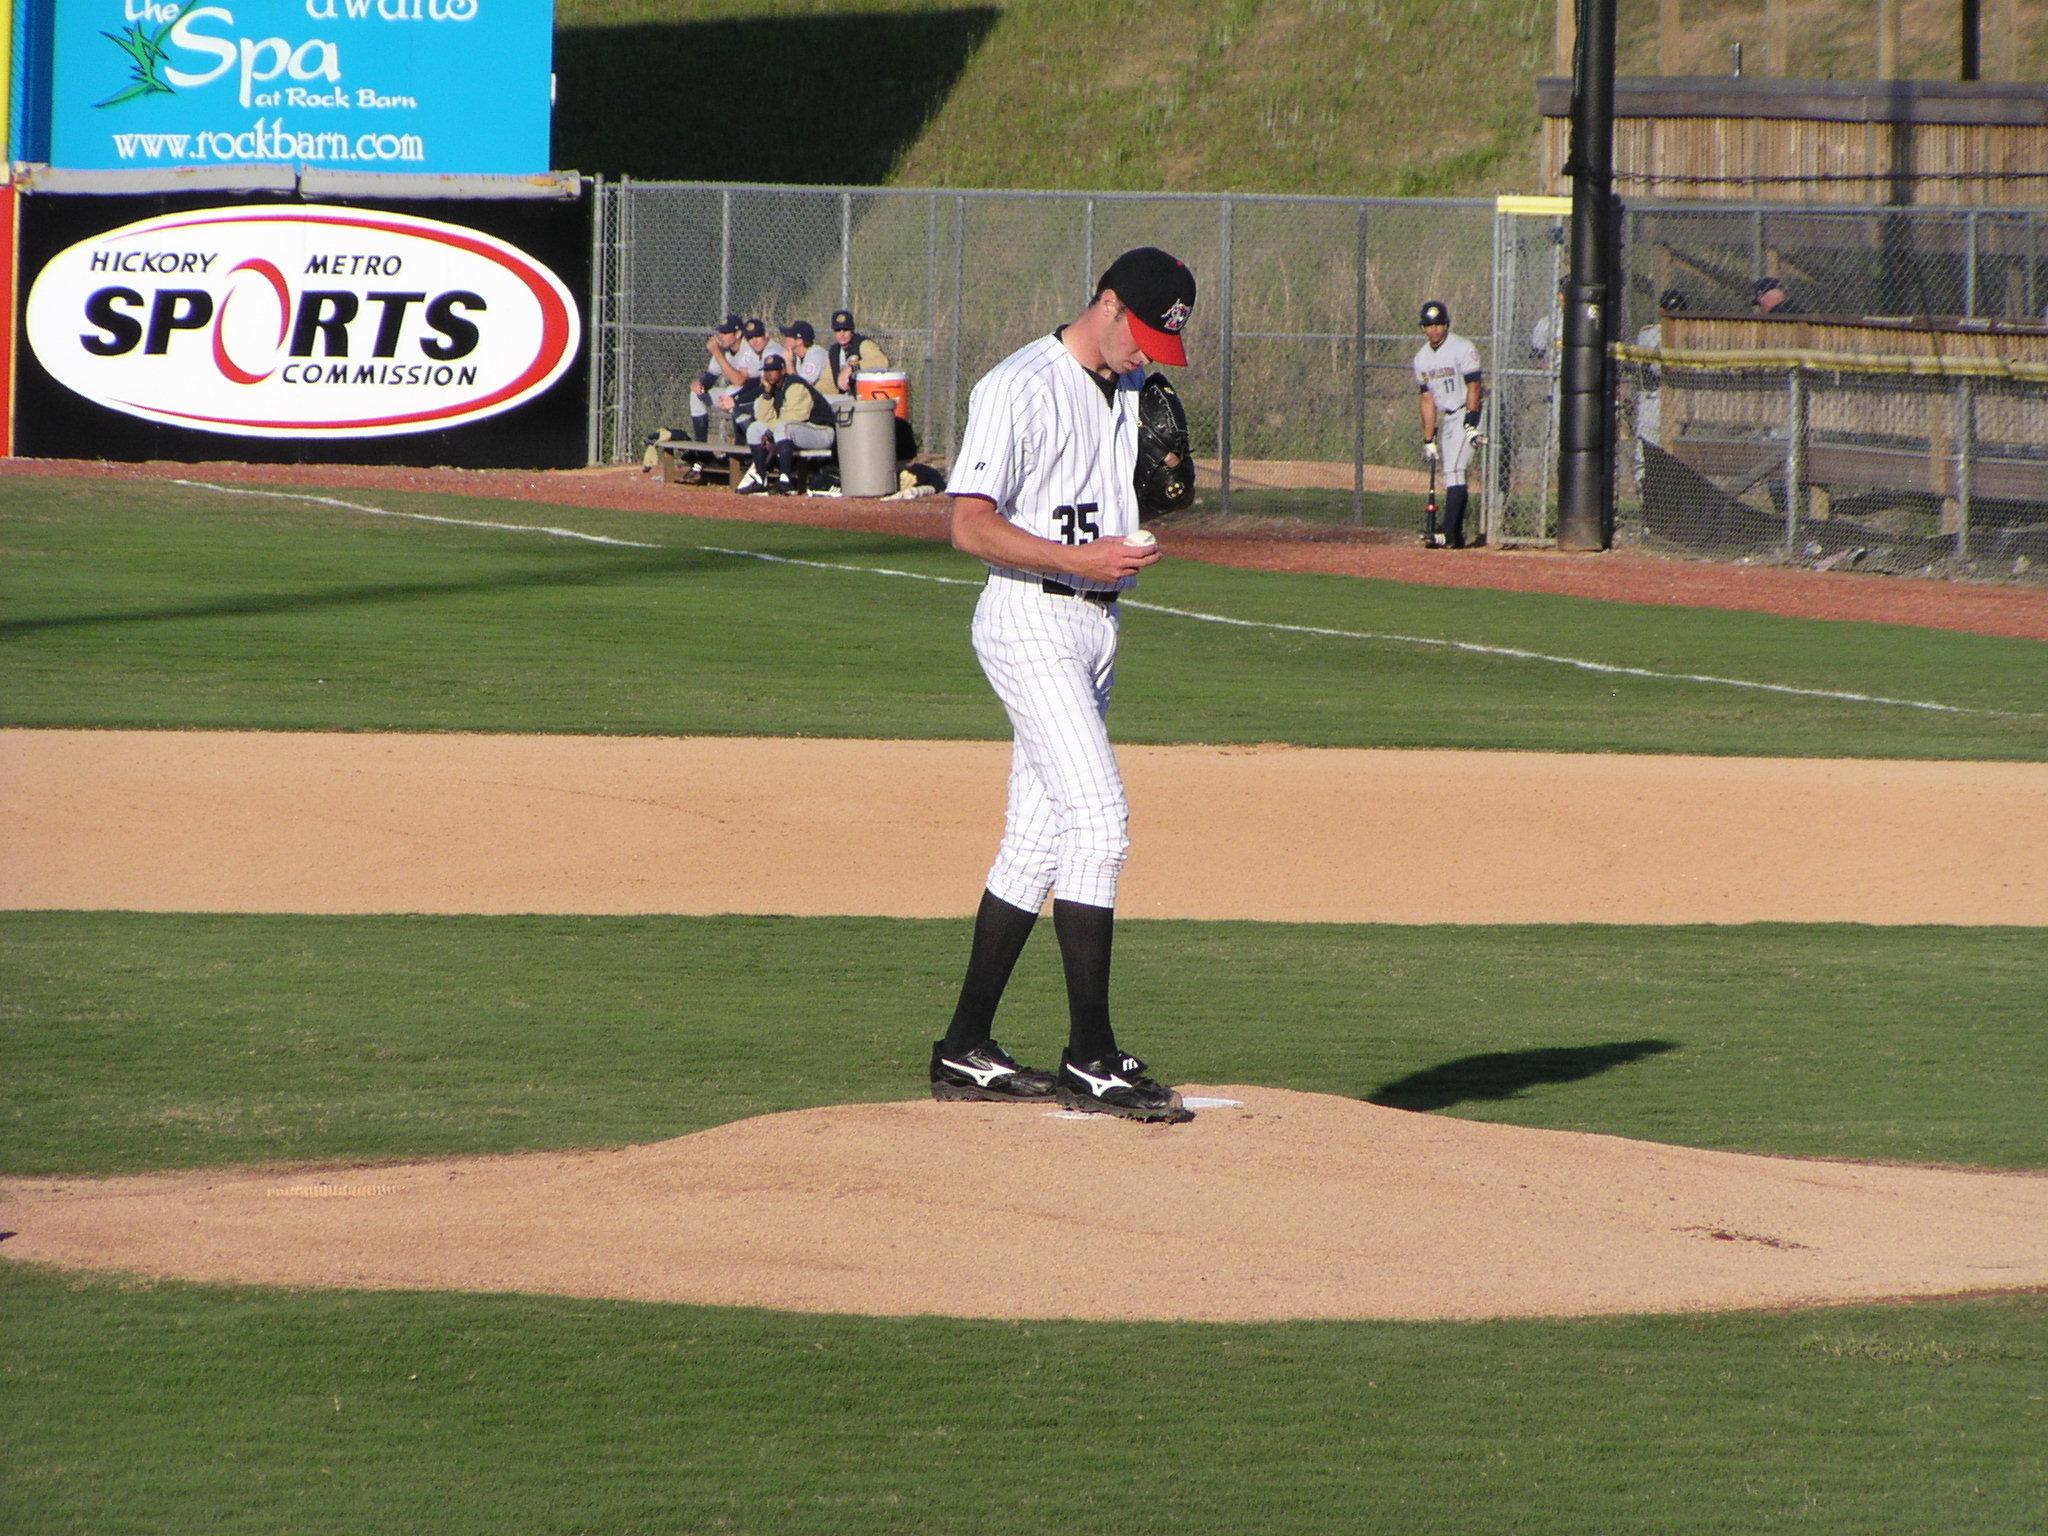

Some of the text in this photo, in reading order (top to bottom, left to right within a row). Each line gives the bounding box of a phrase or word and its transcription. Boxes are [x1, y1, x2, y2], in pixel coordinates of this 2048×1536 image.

[164, 7, 341, 108] Spa
[254, 86, 417, 108] at Rock Barn
[112, 117, 424, 160] www.rockbarn.com
[91, 252, 402, 276] HICKORY METRO
[79, 257, 487, 385] SPORTS
[282, 363, 477, 386] COMMISSION
[1052, 502, 1099, 545] 35
